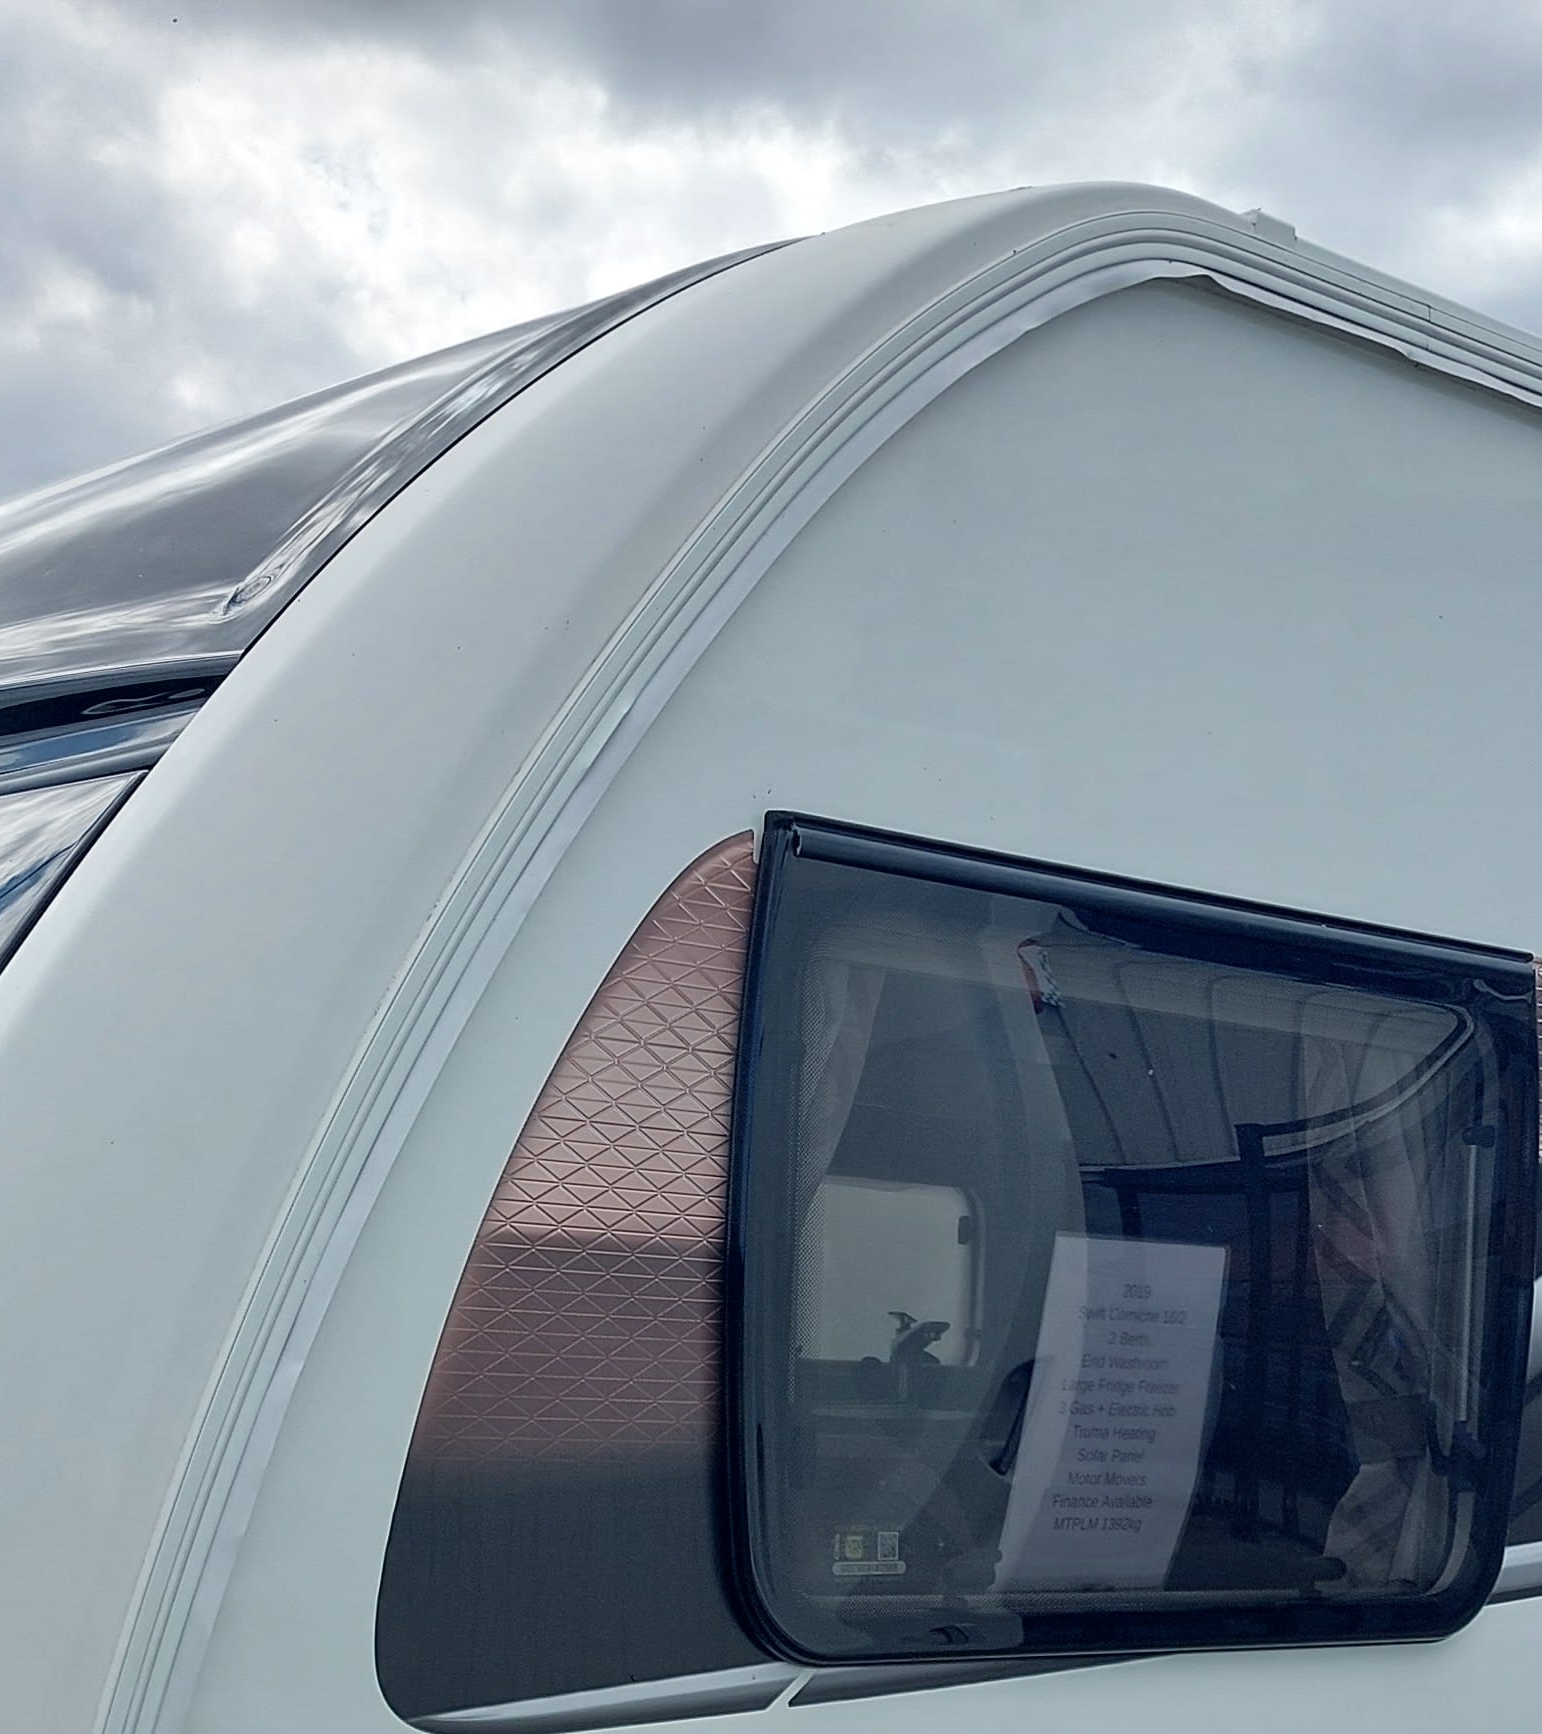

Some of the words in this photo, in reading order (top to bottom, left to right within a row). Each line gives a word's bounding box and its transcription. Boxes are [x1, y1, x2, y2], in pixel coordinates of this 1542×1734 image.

[1123, 1283, 1151, 1299] 2019
[1109, 1332, 1116, 1345] 2
[1120, 1332, 1150, 1346] Berth
[1081, 1353, 1106, 1369] End
[1109, 1355, 1169, 1370] Washroom
[1062, 1379, 1095, 1396] Large
[1098, 1379, 1135, 1397] Fridge
[1138, 1380, 1180, 1395] Freezer
[1069, 1401, 1094, 1416] Gas
[1109, 1402, 1149, 1417] Electric
[1153, 1404, 1177, 1417] Hob
[1074, 1424, 1109, 1440] Truma
[1112, 1425, 1156, 1443] Heating
[1077, 1448, 1108, 1463] Solar
[1111, 1449, 1145, 1463] Panel
[1067, 1472, 1102, 1485] Motor
[1104, 1472, 1147, 1487] Movers
[1052, 1494, 1099, 1509] Finance
[1100, 1495, 1153, 1509] Available
[1053, 1517, 1099, 1531] MTPLM
